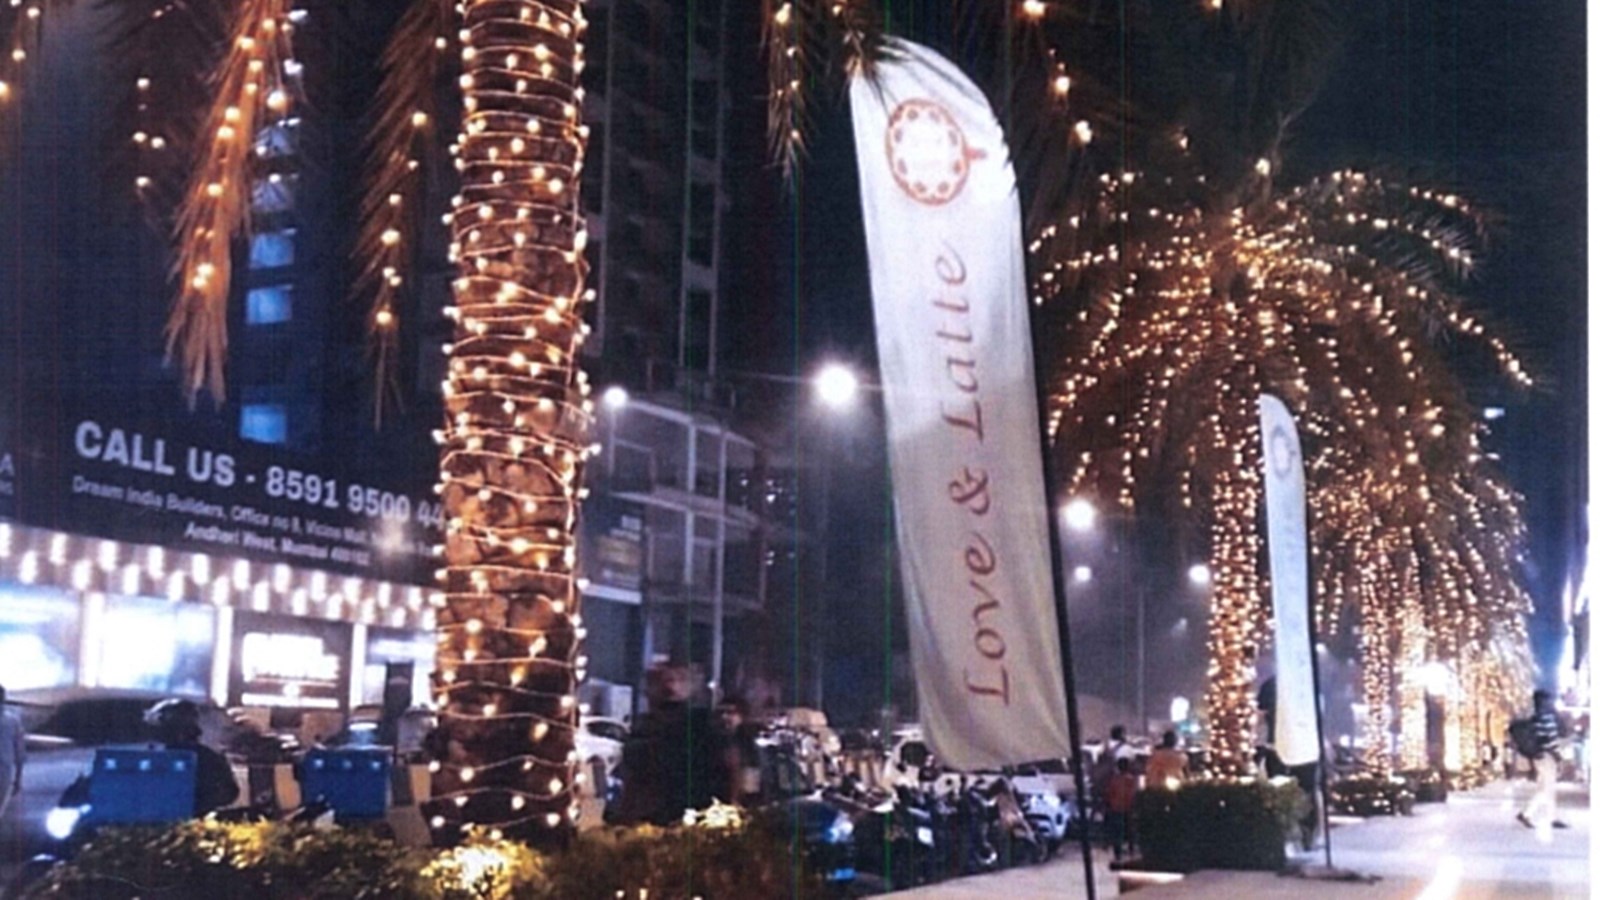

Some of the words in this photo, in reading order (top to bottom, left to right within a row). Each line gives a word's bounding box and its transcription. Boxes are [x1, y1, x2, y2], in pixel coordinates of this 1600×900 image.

[933, 236, 982, 440] Latte
[73, 475, 123, 499] Dream
[127, 487, 163, 507] India
[231, 506, 270, 526] Office
[75, 420, 175, 475] CALL
[187, 446, 236, 487] US
[266, 466, 339, 508] 8591
[346, 484, 411, 523] 9500
[948, 465, 991, 517] &
[184, 521, 241, 545] Andheri
[281, 538, 329, 559] Mumbai
[964, 534, 1009, 706] Love
